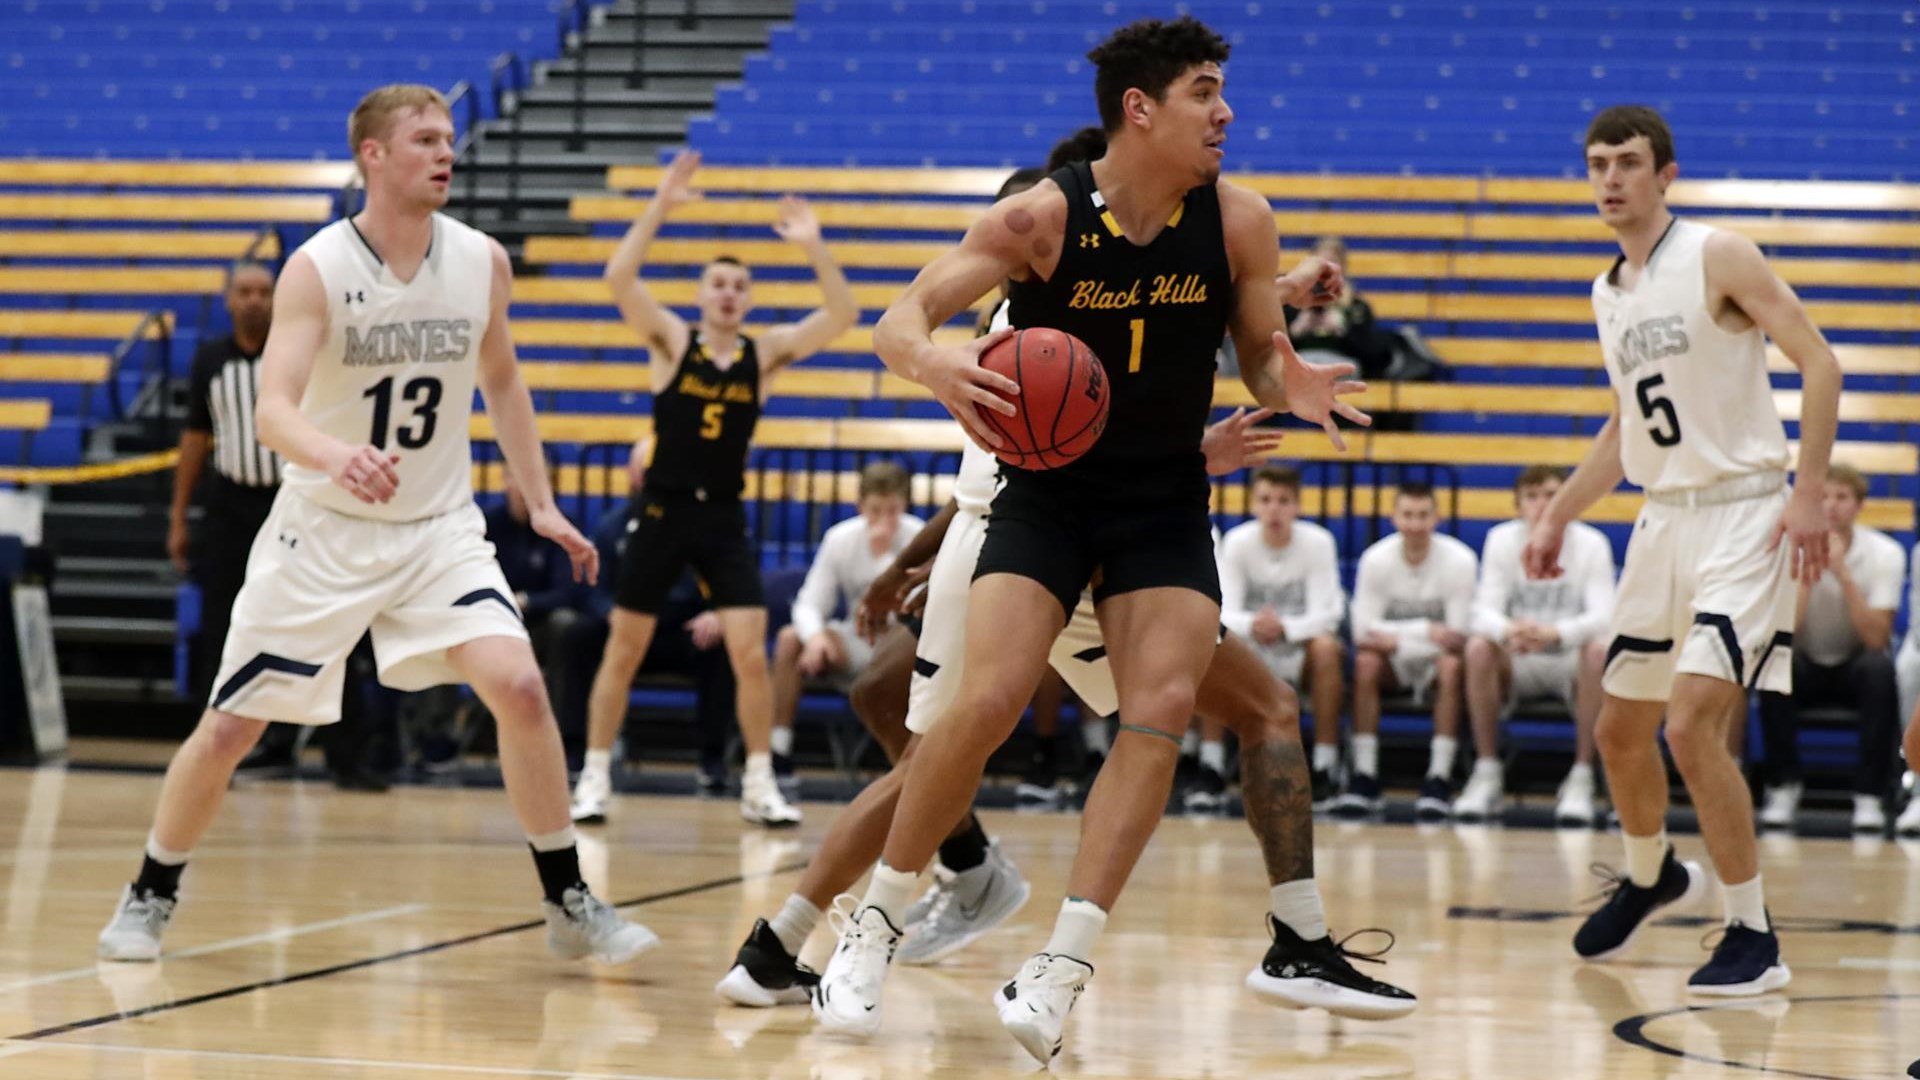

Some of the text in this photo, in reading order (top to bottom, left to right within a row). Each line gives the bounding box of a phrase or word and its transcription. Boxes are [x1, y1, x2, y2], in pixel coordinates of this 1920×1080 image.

[1069, 273, 1208, 310] Black Hills
[343, 319, 472, 367] MINES
[1128, 318, 1145, 373] 1
[1616, 315, 1690, 376] INES
[362, 375, 443, 451] 13
[700, 403, 725, 440] 5
[1636, 372, 1682, 447] 5
